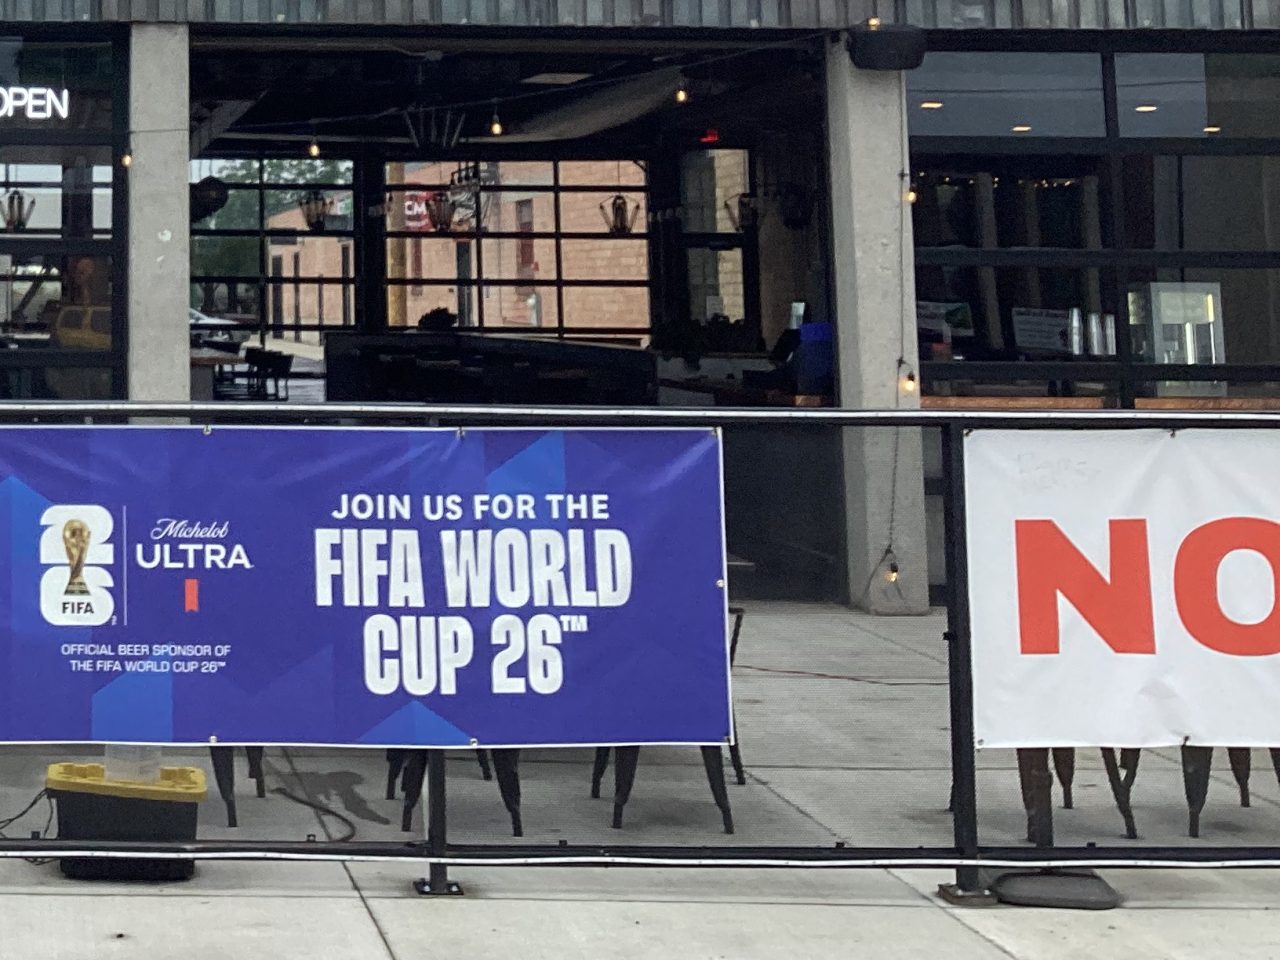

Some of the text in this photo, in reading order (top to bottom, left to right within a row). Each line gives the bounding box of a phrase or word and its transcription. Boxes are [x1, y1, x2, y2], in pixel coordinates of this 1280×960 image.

[332, 494, 610, 521] JOIN US FOR THE
[150, 518, 229, 540] Michelob
[136, 543, 254, 569] ULTRA
[315, 528, 632, 608] FIFA WORLD
[1014, 516, 1280, 657] NO
[62, 601, 95, 614] FIFA
[61, 644, 231, 657] OFFICIAL BEER SPONSOR OF
[363, 614, 474, 695] CUP
[70, 660, 94, 671] THE
[97, 660, 121, 671] FIFA
[125, 660, 169, 672] WORLD
[173, 660, 198, 672] CUP
